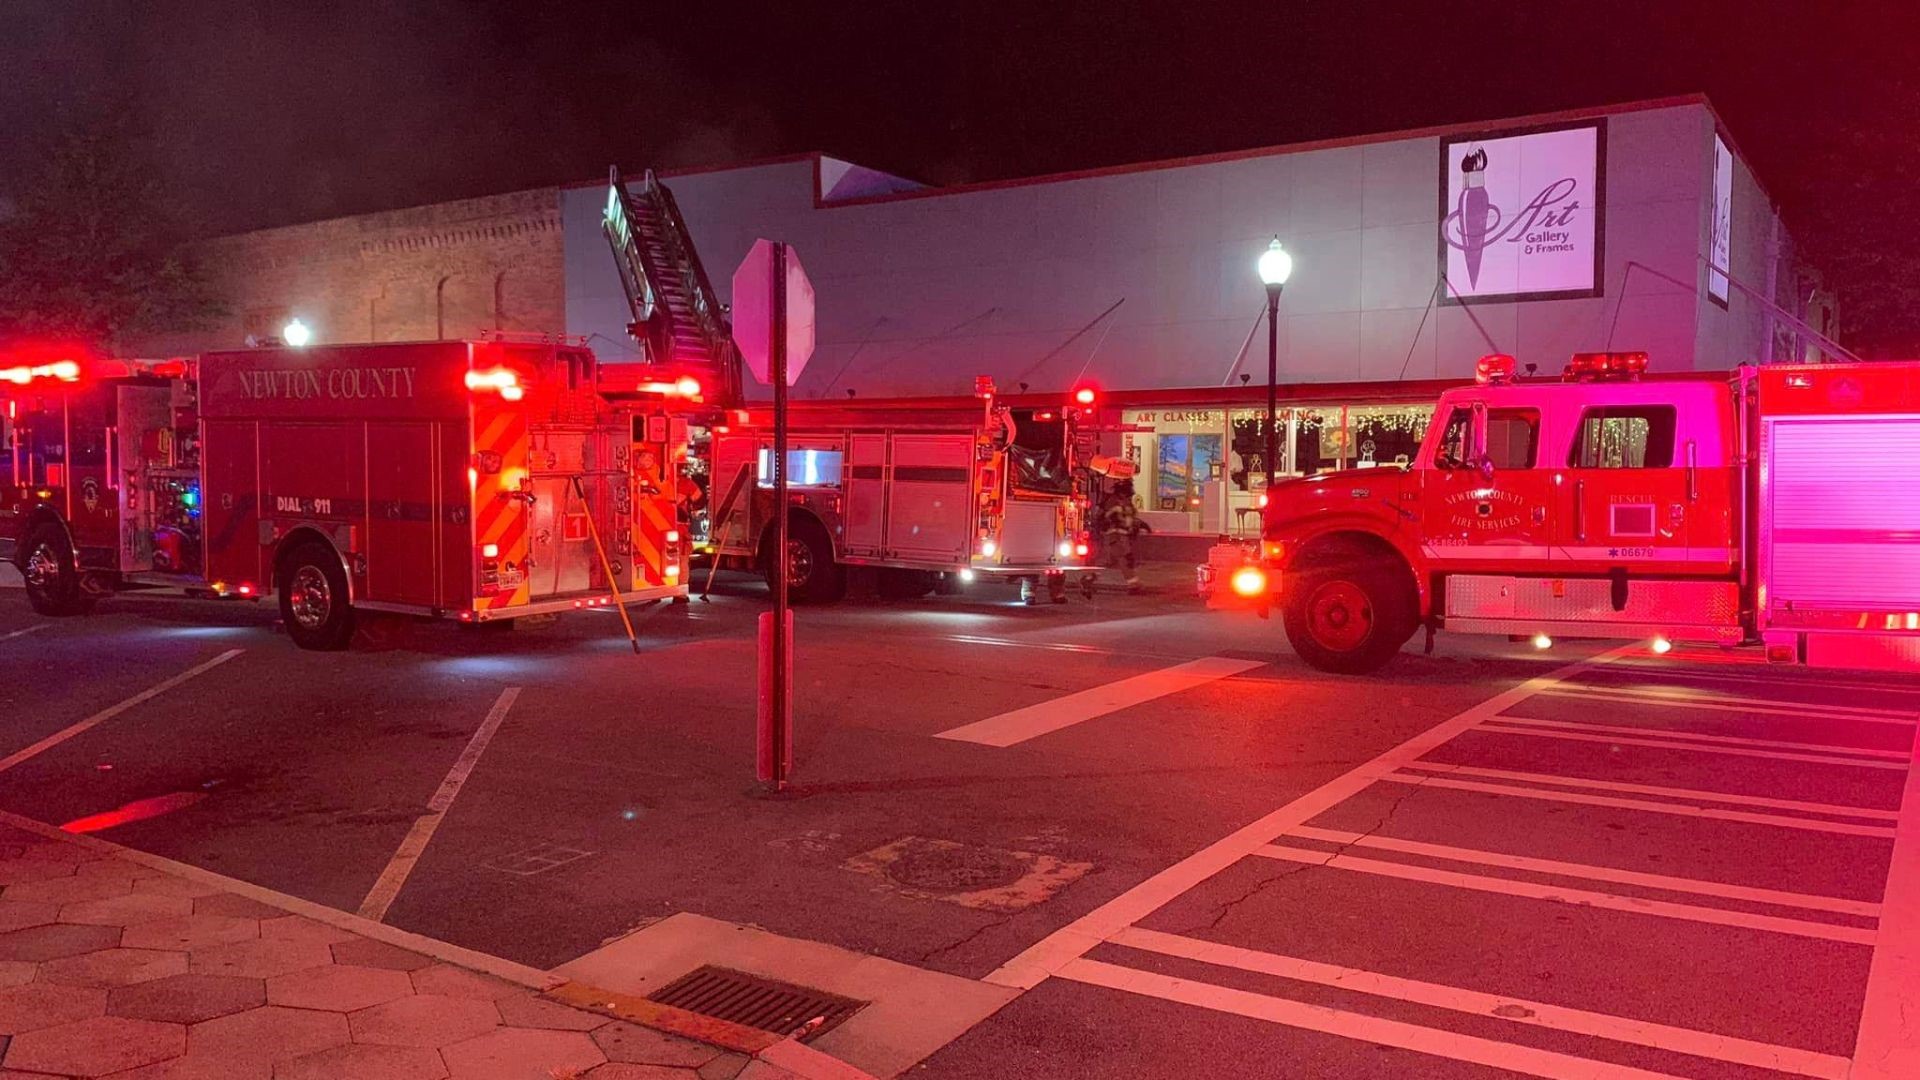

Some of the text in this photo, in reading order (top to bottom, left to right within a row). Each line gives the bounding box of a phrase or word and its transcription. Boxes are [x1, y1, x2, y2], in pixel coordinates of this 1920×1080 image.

[1506, 177, 1580, 242] Art
[1525, 231, 1570, 244] Gallery
[1524, 243, 1575, 255] & Frames
[239, 367, 417, 399] NEWTON COUNTY
[1136, 411, 1210, 423] ART CLASSES
[1254, 409, 1316, 421] FRMING
[277, 496, 331, 514] DIAL 911
[1444, 489, 1523, 506] NEWTON COUNTY
[1610, 494, 1656, 504] RESCUE
[571, 518, 582, 538] 1
[1451, 514, 1520, 530] FIRE SERVICES
